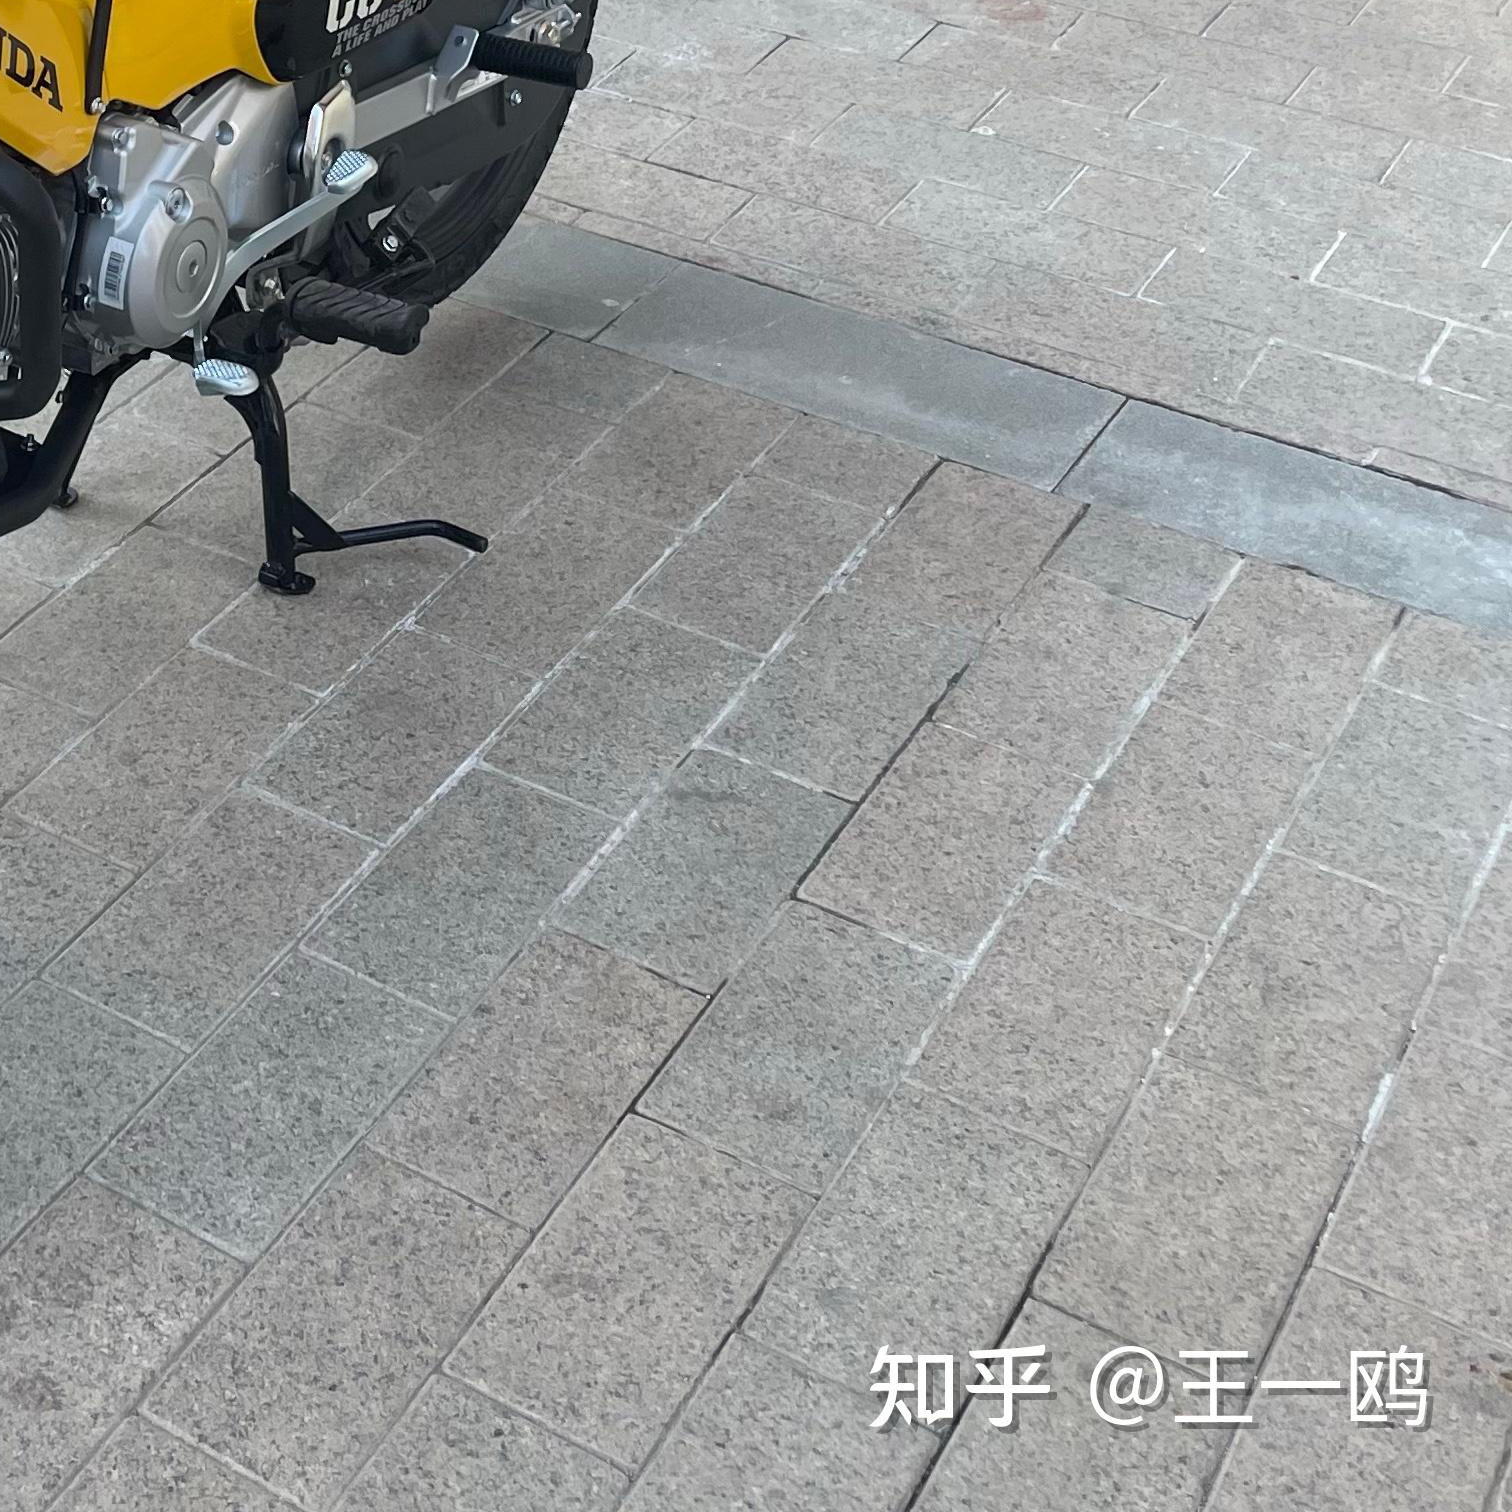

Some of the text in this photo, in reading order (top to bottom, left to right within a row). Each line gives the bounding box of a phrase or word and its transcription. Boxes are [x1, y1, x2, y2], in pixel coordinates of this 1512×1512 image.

[331, 44, 342, 59] A
[344, 29, 373, 53] LIFE
[373, 13, 400, 38] AND
[336, 23, 361, 44] THE
